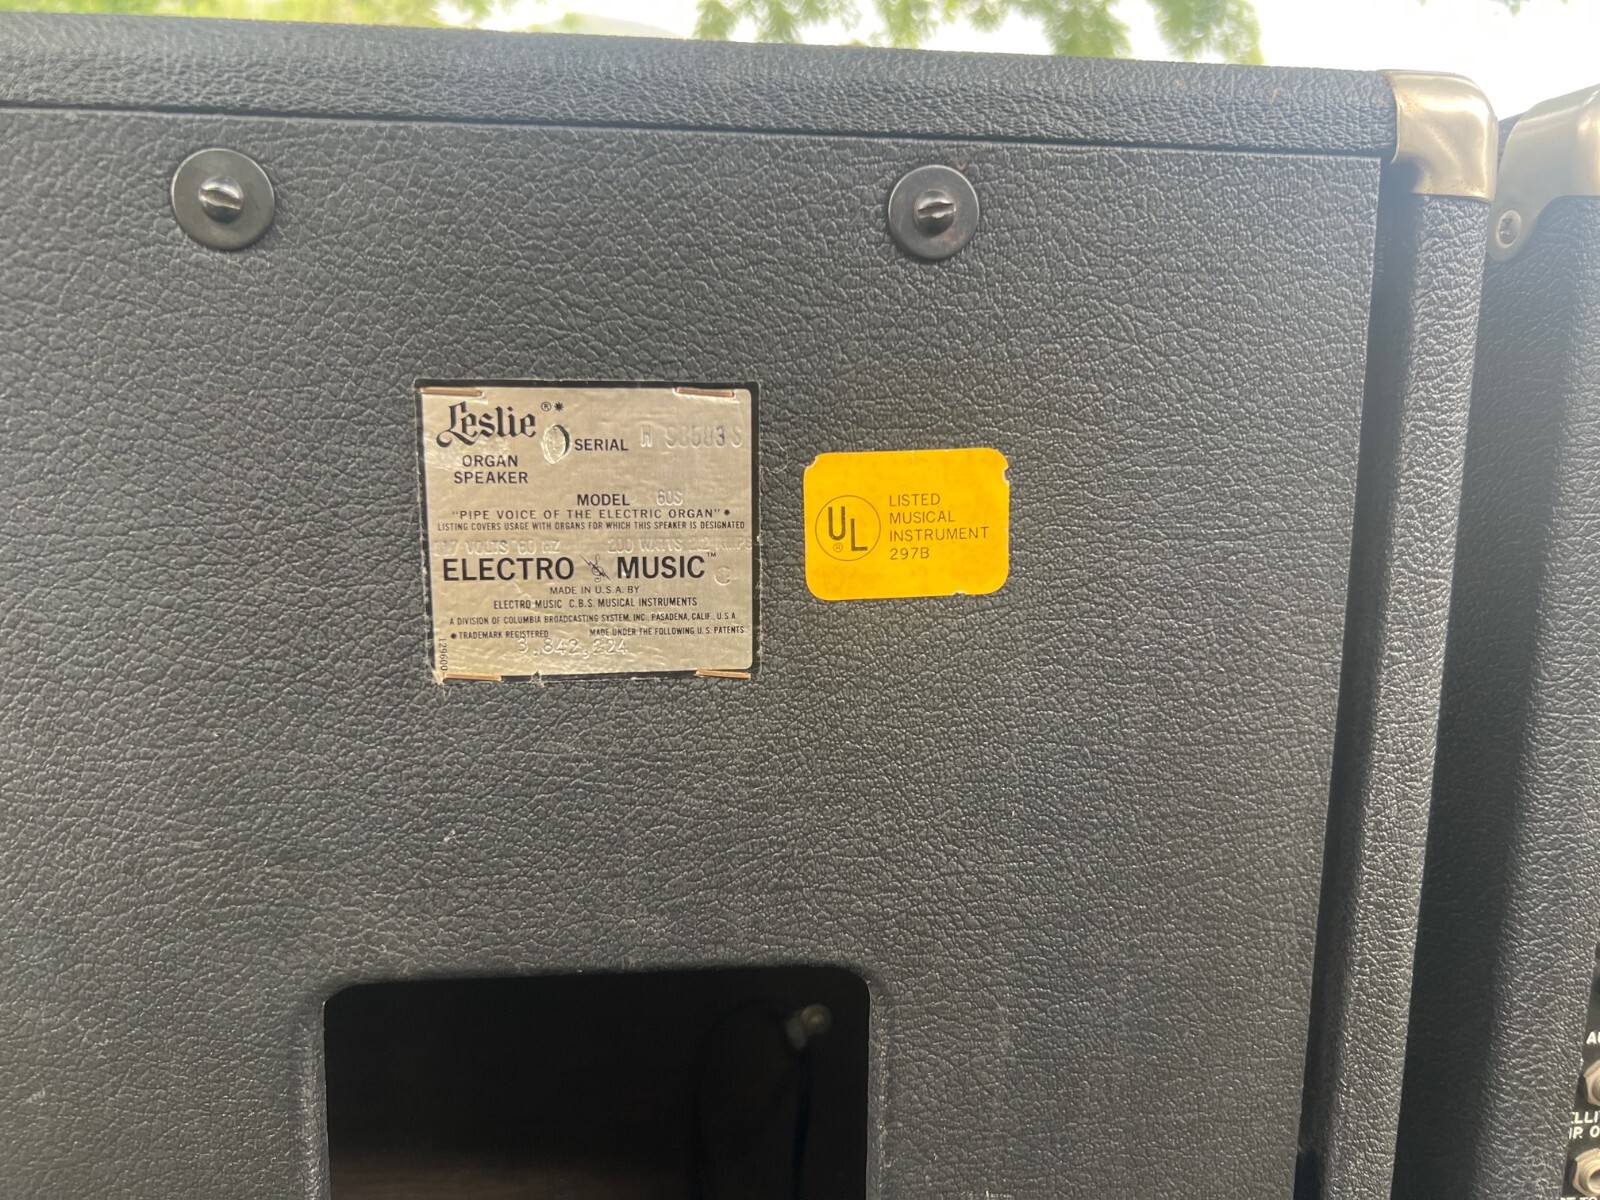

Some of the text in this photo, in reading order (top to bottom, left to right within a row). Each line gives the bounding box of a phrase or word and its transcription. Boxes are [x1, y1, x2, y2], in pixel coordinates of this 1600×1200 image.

[436, 401, 536, 448] Leslie
[574, 438, 629, 451] SERIAL
[462, 454, 518, 467] ORGAN
[454, 471, 529, 484] SPEAKER
[577, 493, 630, 506] MODEL
[889, 493, 941, 507] LISTED
[496, 509, 537, 519] VOICE
[543, 509, 560, 519] OF
[566, 509, 592, 519] THE
[599, 508, 662, 519] ELECTRIC
[889, 510, 955, 525] MUSICAL
[438, 520, 745, 532] LISTING COVERS USAGE WITH ORGANS FOR WHICH THIS SPEAKER IS DESIGNATED
[827, 505, 868, 552] UL
[889, 526, 990, 542] INSTRUMENT
[889, 547, 930, 560] 297B
[443, 557, 575, 581] ELECTRO
[617, 555, 705, 579] MUSIC
[549, 586, 577, 595] MADE
[581, 586, 591, 595] IN
[627, 585, 640, 594] BY
[493, 599, 532, 610] ELECTRO
[534, 599, 562, 609] MUSIC
[597, 598, 635, 608] MUSICAL
[638, 597, 698, 607] INSTRUMENTS
[457, 617, 489, 625] DIVISION
[492, 616, 501, 624] OF
[503, 616, 541, 624] COLUMBIA
[544, 614, 599, 623] BROADCASTING
[458, 630, 549, 640] TRADEMARK REGISTERED
[589, 628, 609, 636] MADE
[612, 628, 637, 636] UNDER
[639, 627, 652, 635] THE
[654, 626, 695, 635] FOLLOWING
[714, 626, 745, 635] PATENTS
